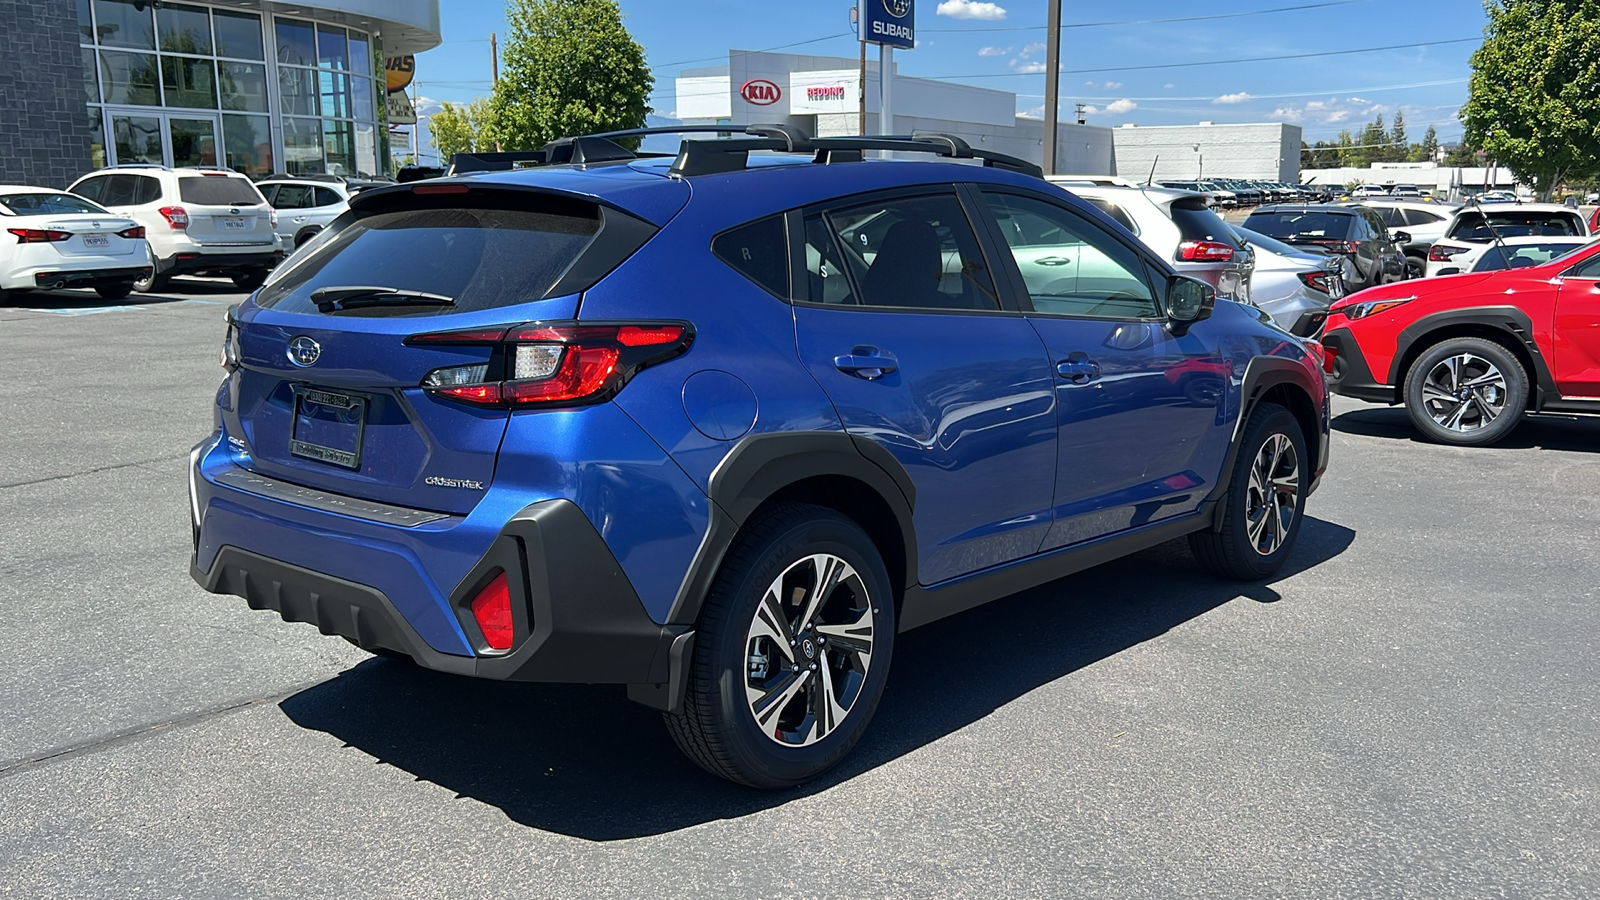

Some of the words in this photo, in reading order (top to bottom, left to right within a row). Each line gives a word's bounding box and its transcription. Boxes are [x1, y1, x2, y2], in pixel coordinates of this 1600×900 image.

[873, 20, 913, 40] SUBARU
[749, 85, 775, 100] KIA
[807, 86, 845, 97] REDDING
[860, 233, 868, 246] 9
[741, 247, 752, 261] R
[820, 265, 828, 278] S
[425, 476, 484, 490] CROSSTREK
